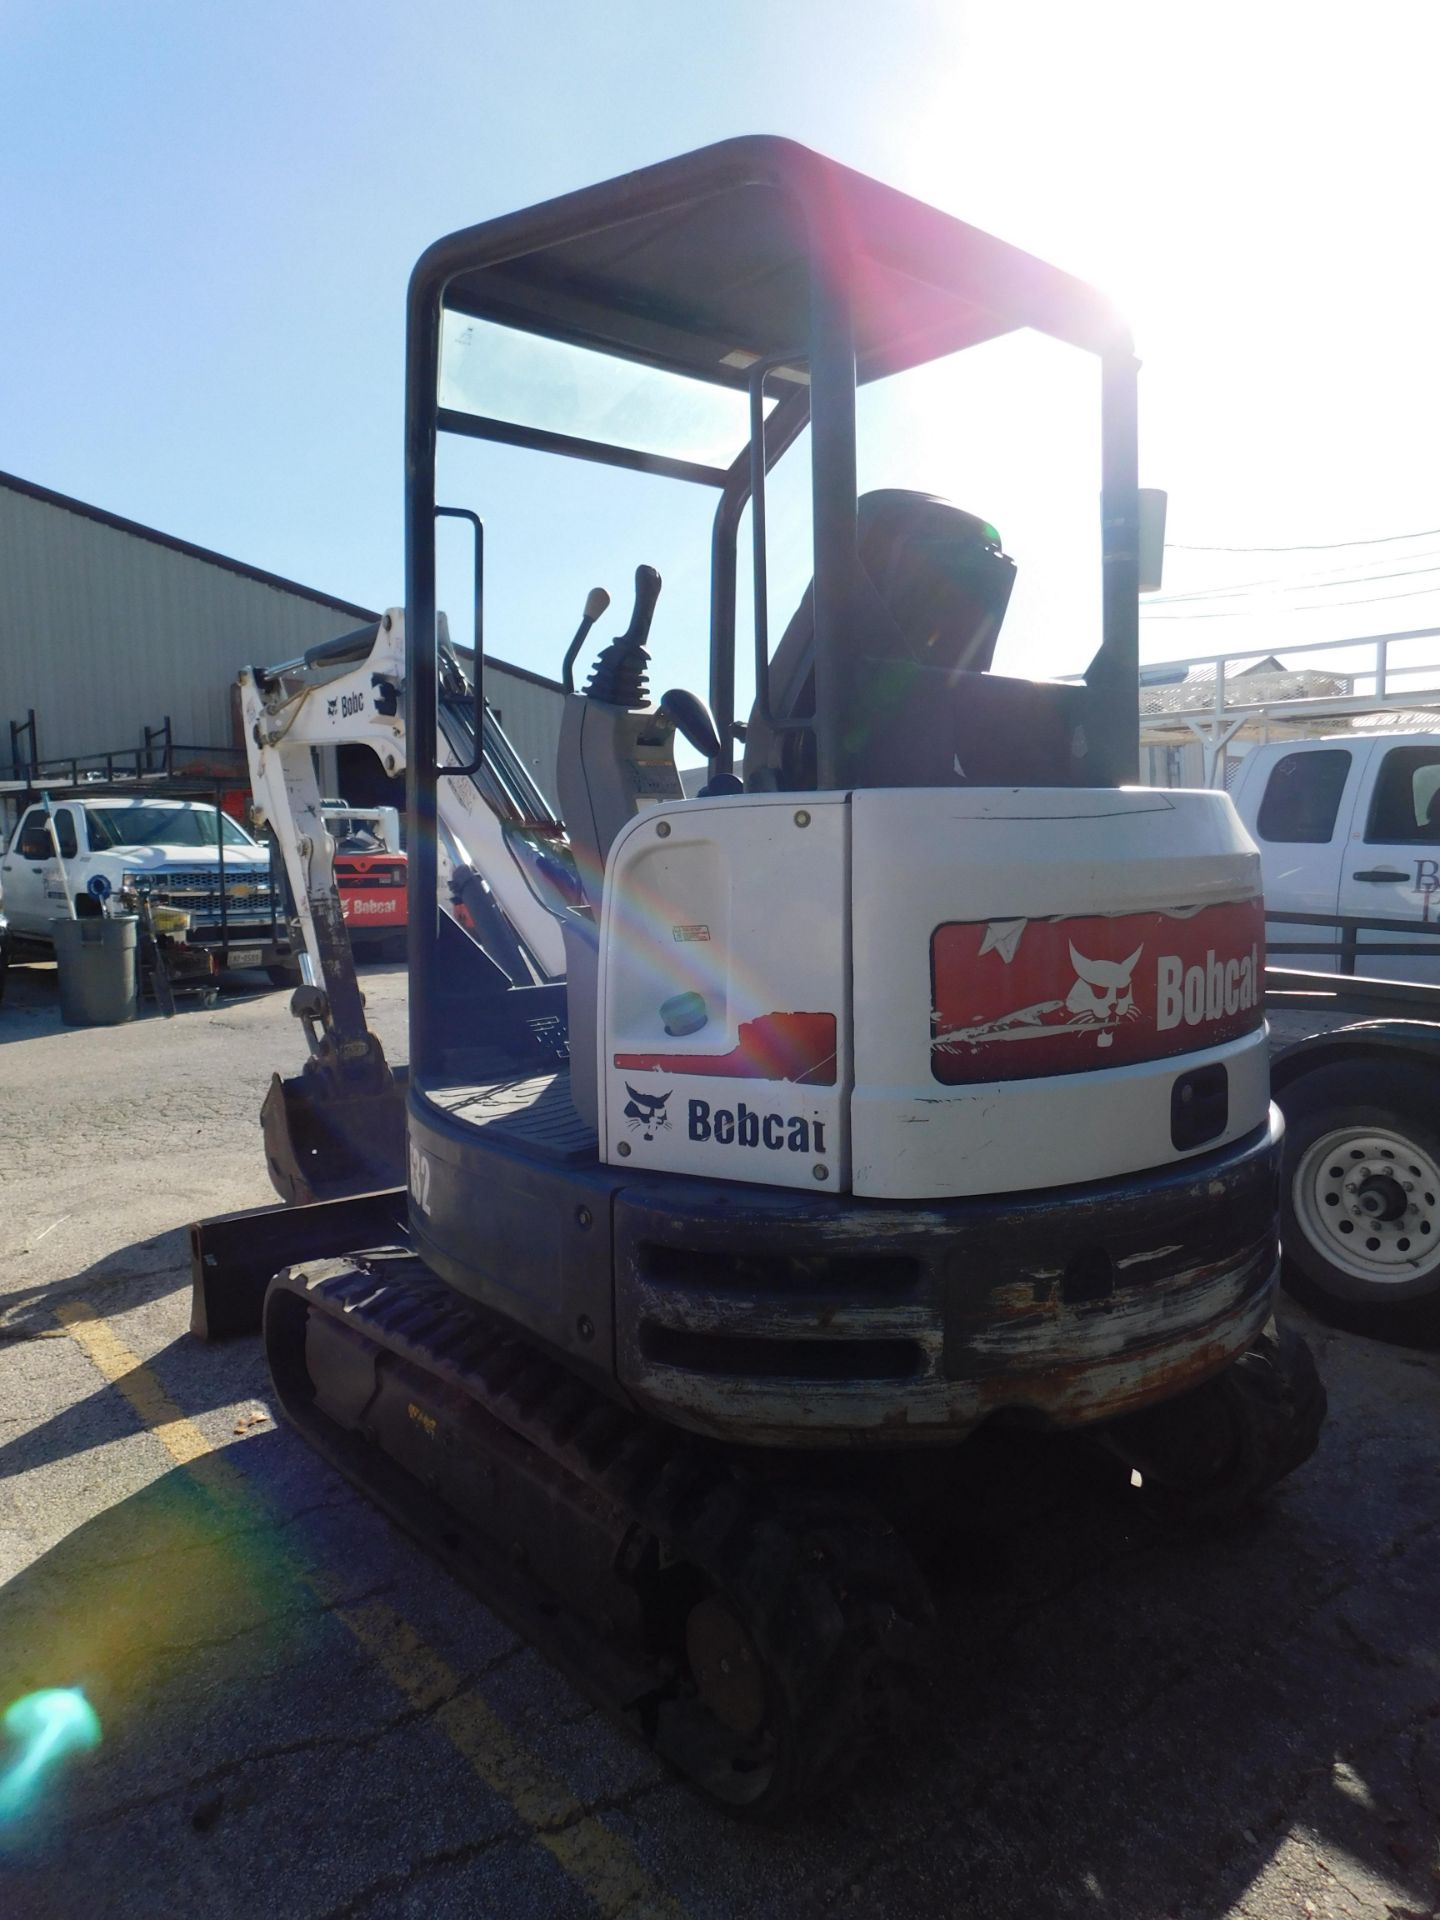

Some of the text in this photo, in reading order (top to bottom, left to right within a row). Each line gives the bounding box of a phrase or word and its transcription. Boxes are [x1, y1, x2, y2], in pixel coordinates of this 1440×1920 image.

[353, 899, 396, 914] Bobcat
[1156, 942, 1258, 1032] Bobcat
[688, 1099, 827, 1153] Bobcat
